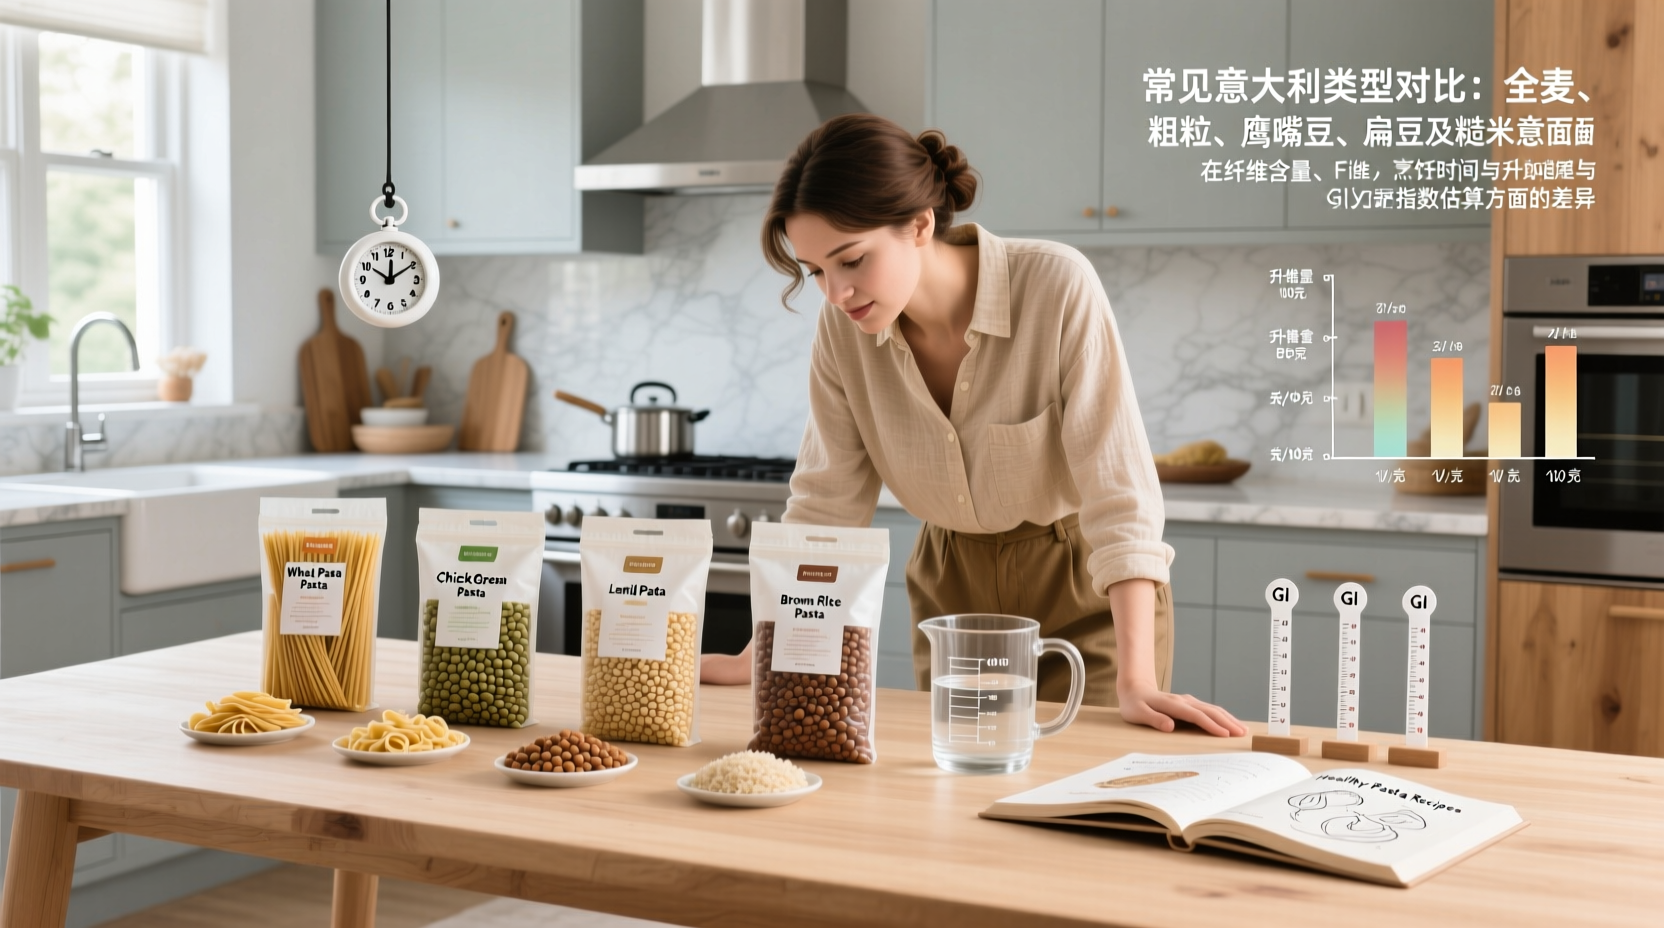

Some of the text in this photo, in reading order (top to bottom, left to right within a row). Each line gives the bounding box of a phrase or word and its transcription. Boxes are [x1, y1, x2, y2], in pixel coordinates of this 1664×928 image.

[384, 247, 394, 258] 12
[400, 251, 404, 260] 1
[362, 261, 371, 271] 10
[359, 275, 366, 284] 9
[374, 298, 381, 308] 7
[387, 302, 394, 310] 6
[436, 571, 472, 586] Chick
[457, 586, 486, 598] Pasta
[1272, 586, 1290, 602] GI
[1340, 590, 1358, 606] GI
[780, 594, 814, 606] Brown
[1410, 594, 1428, 610] GI
[794, 607, 825, 620] Pasta
[1370, 782, 1408, 800] Pasta
